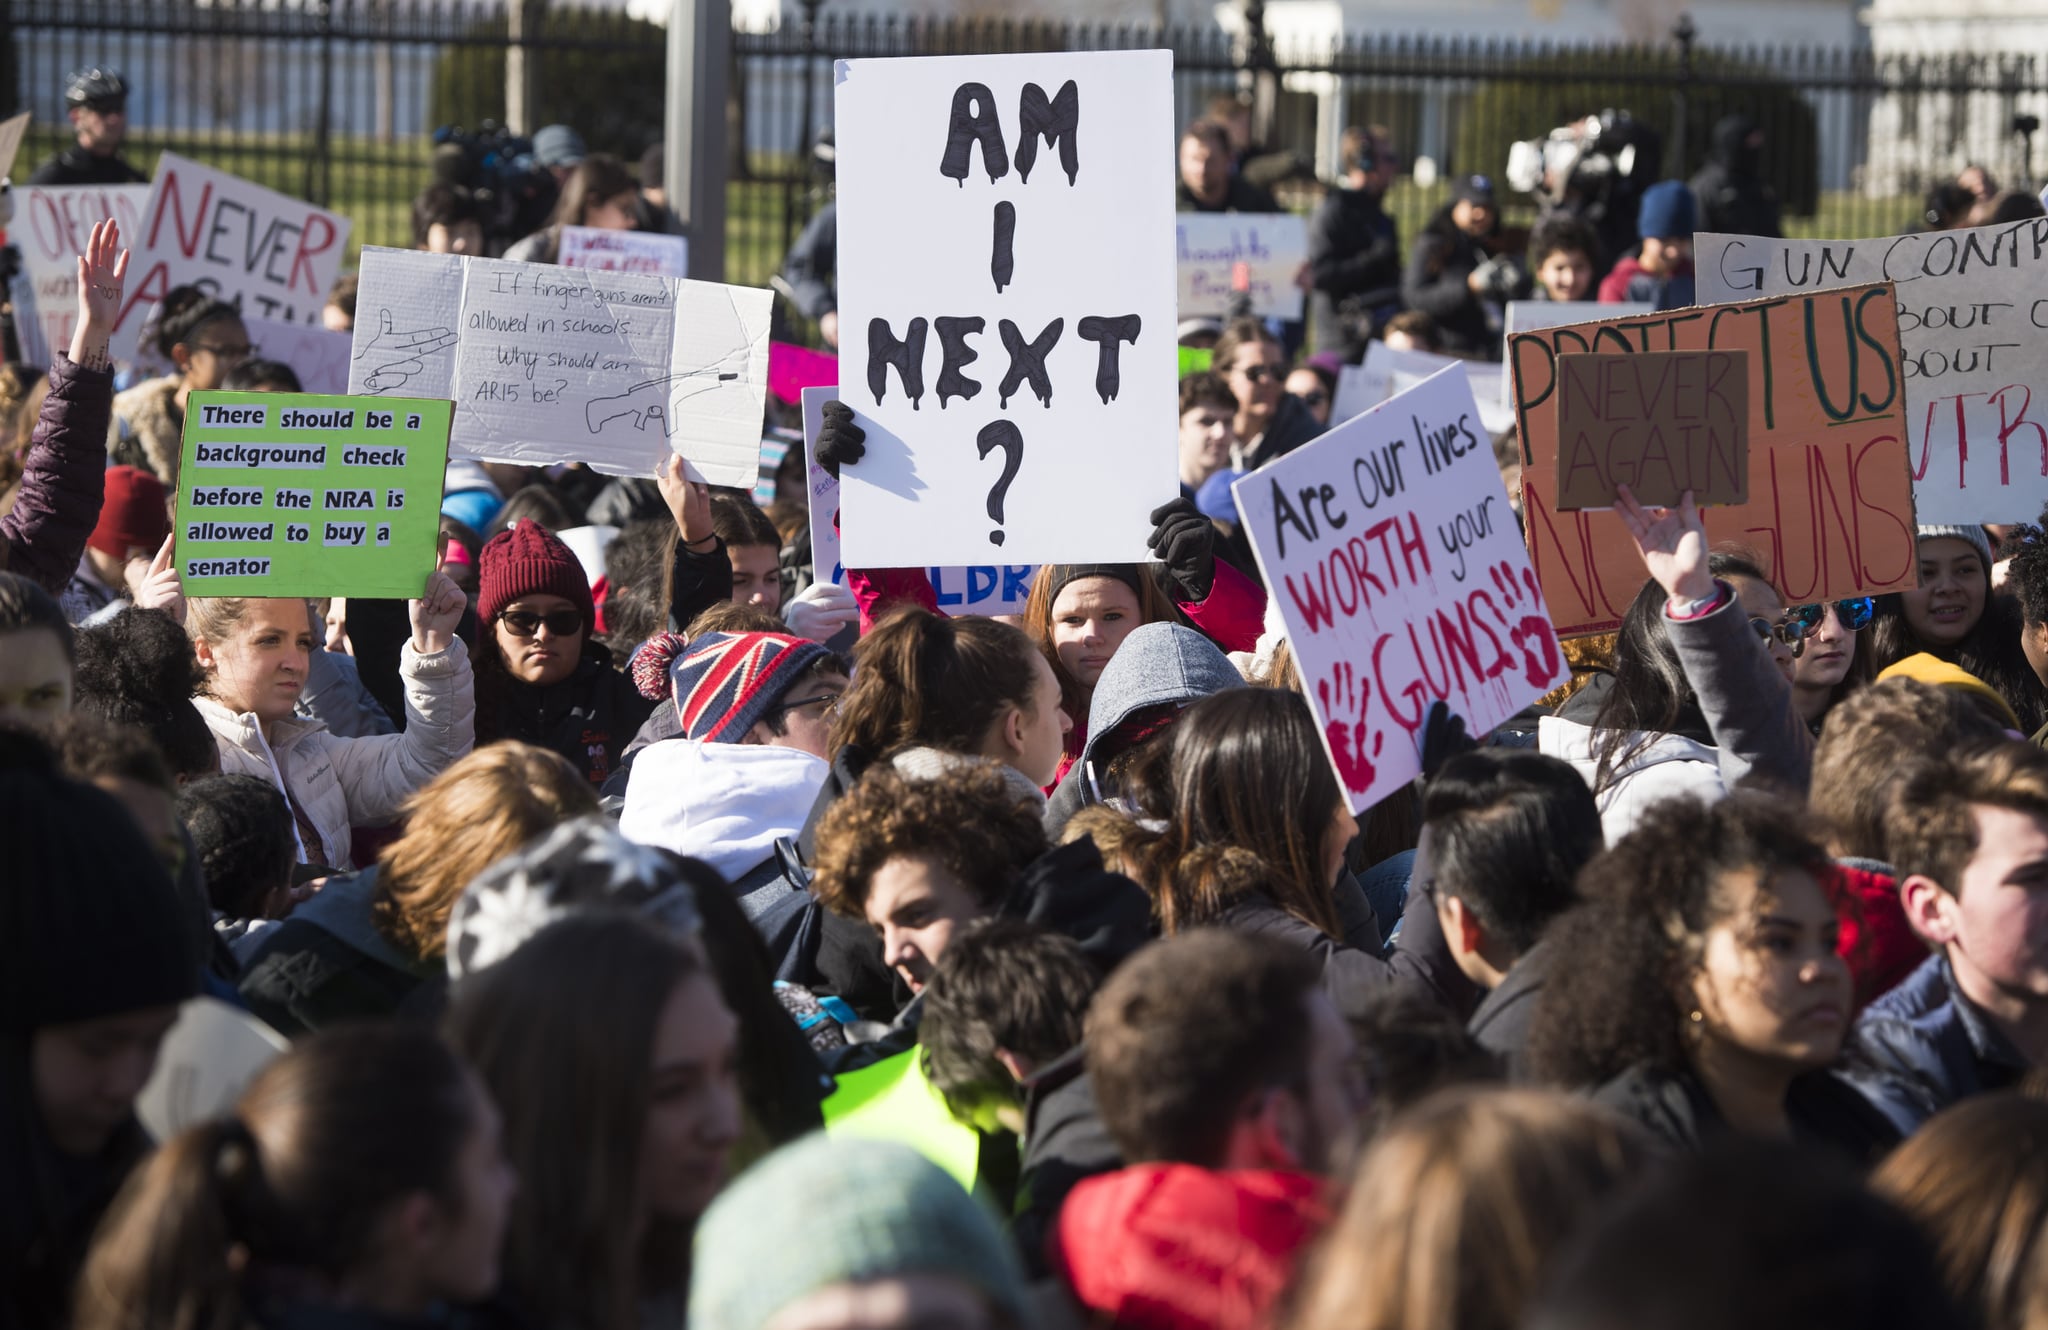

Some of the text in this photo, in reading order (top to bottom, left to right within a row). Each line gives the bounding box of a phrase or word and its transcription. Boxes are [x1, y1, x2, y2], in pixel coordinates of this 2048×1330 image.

[940, 79, 1079, 188] AM
[146, 169, 336, 296] NEVER
[991, 200, 1016, 294] I
[490, 271, 668, 310] If finger guns aren't
[1720, 241, 1854, 290] GUN
[469, 310, 528, 333] allowed
[537, 317, 554, 333] in
[498, 345, 629, 380] Why should an
[867, 313, 1141, 410] NEXT
[1803, 289, 1897, 420] US
[203, 406, 420, 429] There should be a
[475, 379, 568, 405] AR15 be?
[1564, 352, 1736, 424] NEVER
[196, 444, 406, 467] background check
[976, 419, 1024, 546] ?
[1565, 423, 1740, 495] AGAIN
[192, 488, 404, 508] before the NRA is
[1269, 476, 1347, 560] Are
[1413, 413, 1477, 476] lives
[188, 522, 390, 545] allowed to buy a
[188, 558, 270, 576] senator
[1284, 495, 1495, 634] WORTH your
